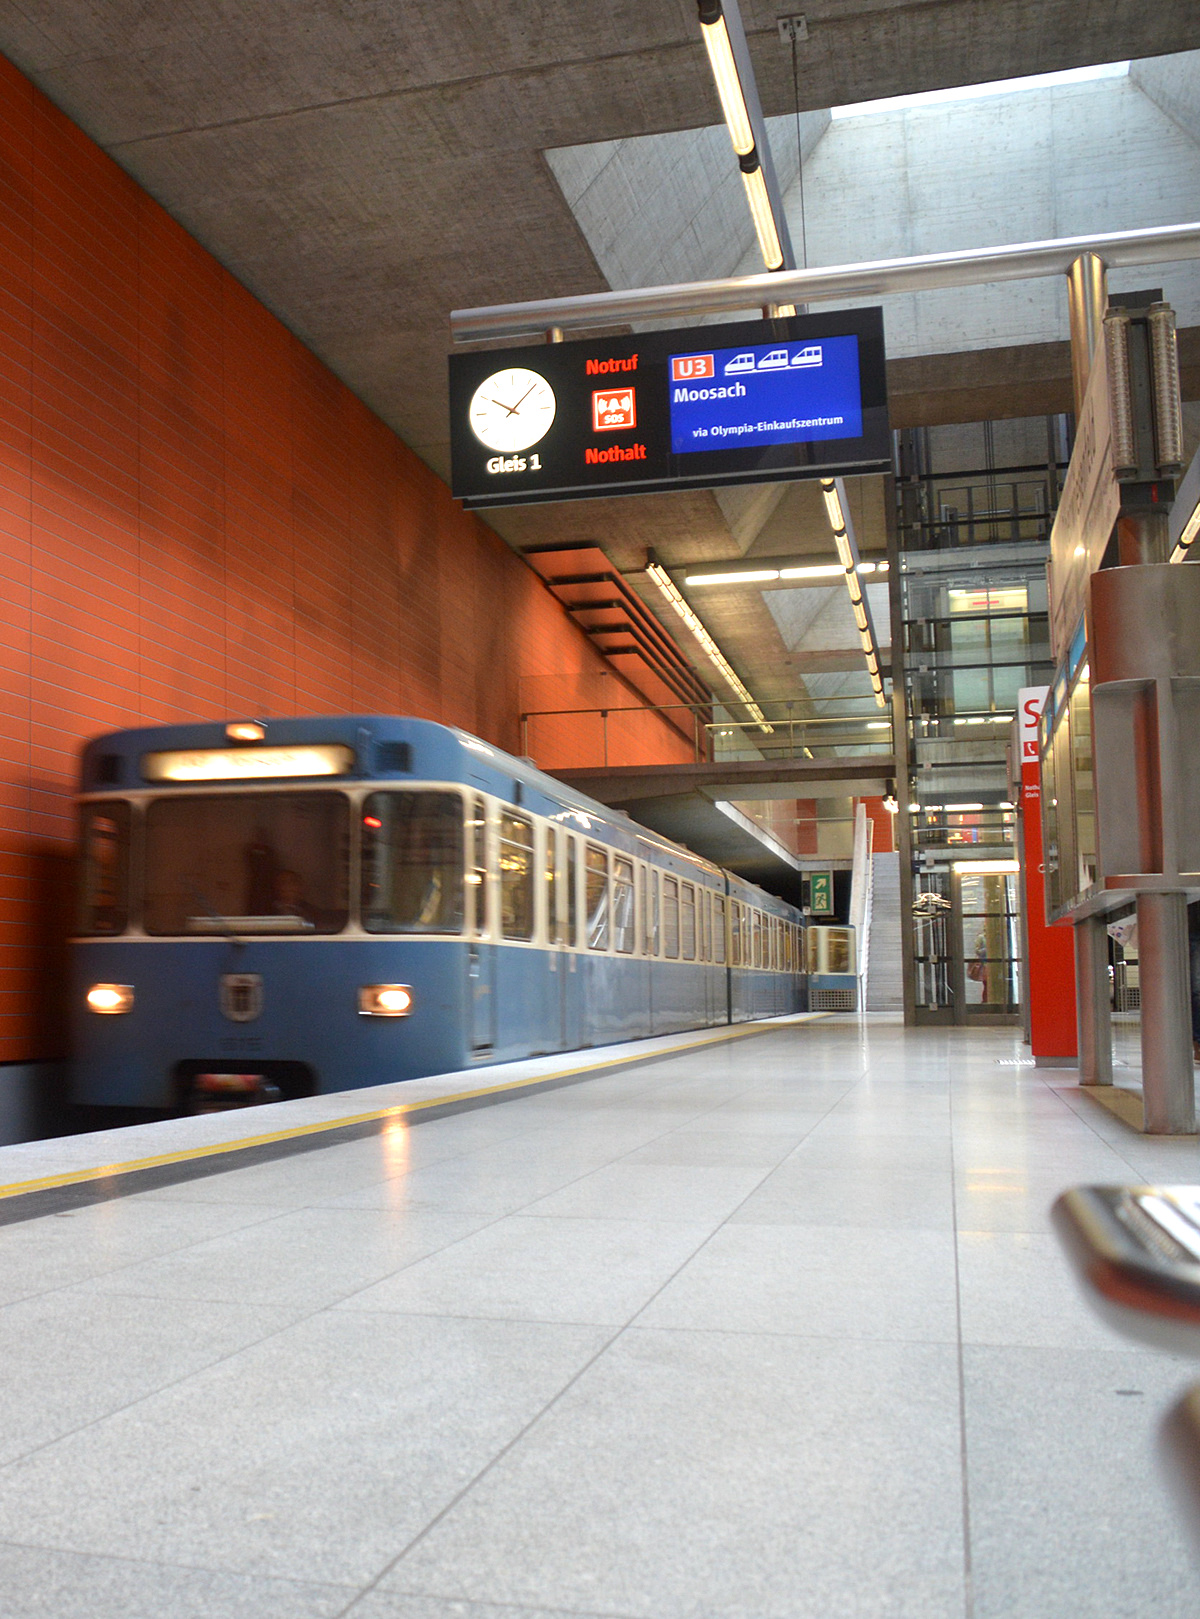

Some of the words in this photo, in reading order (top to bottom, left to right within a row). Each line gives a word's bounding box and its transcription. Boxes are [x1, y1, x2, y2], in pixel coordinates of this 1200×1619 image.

[585, 354, 639, 376] Notruf
[678, 358, 708, 377] U3
[673, 381, 747, 403] Moosach
[604, 413, 625, 425] SOS
[692, 427, 708, 438] via
[710, 416, 844, 438] Olympia-Einkaufszentrum
[486, 454, 527, 474] Gleis
[529, 453, 542, 471] 1
[585, 443, 648, 465] Nothalt
